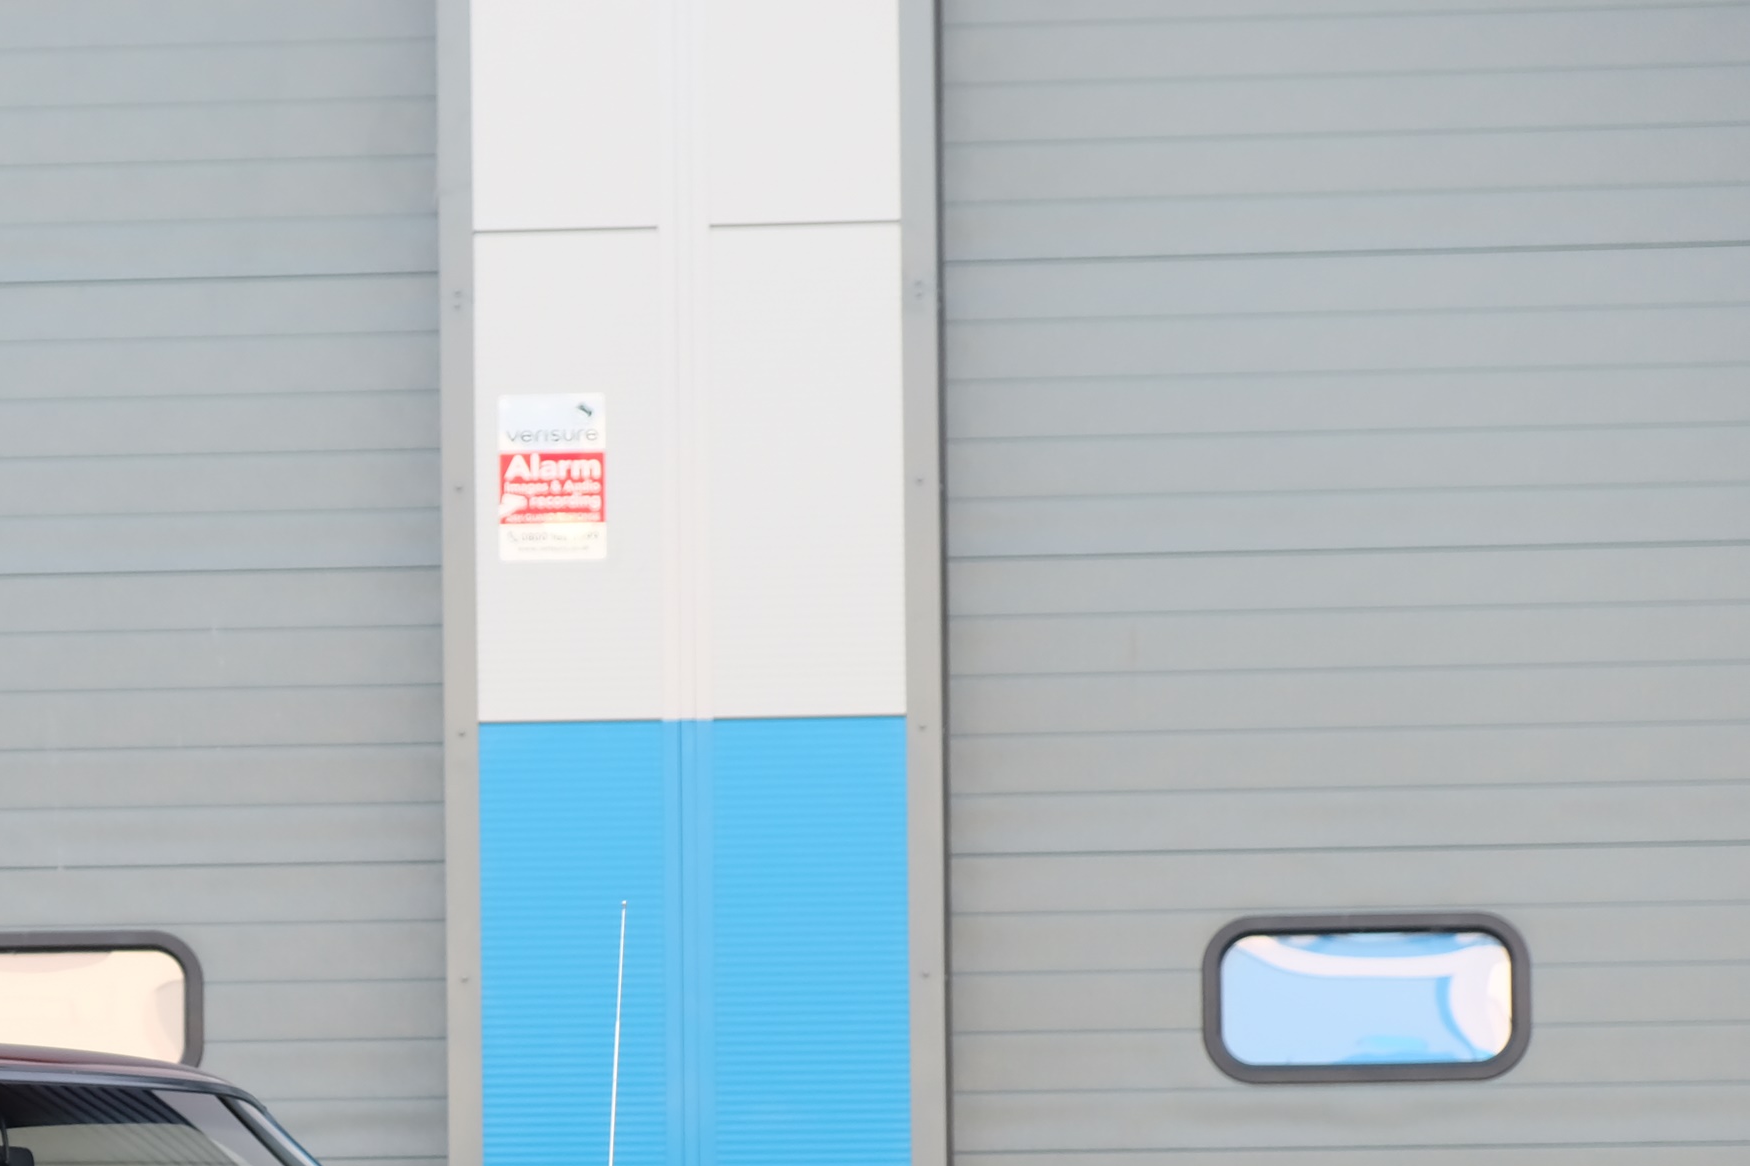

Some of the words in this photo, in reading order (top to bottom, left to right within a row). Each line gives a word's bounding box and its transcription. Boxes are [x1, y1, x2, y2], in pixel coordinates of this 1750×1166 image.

[506, 428, 599, 442] verisure
[503, 452, 602, 480] Alarm
[529, 493, 602, 512] recording
